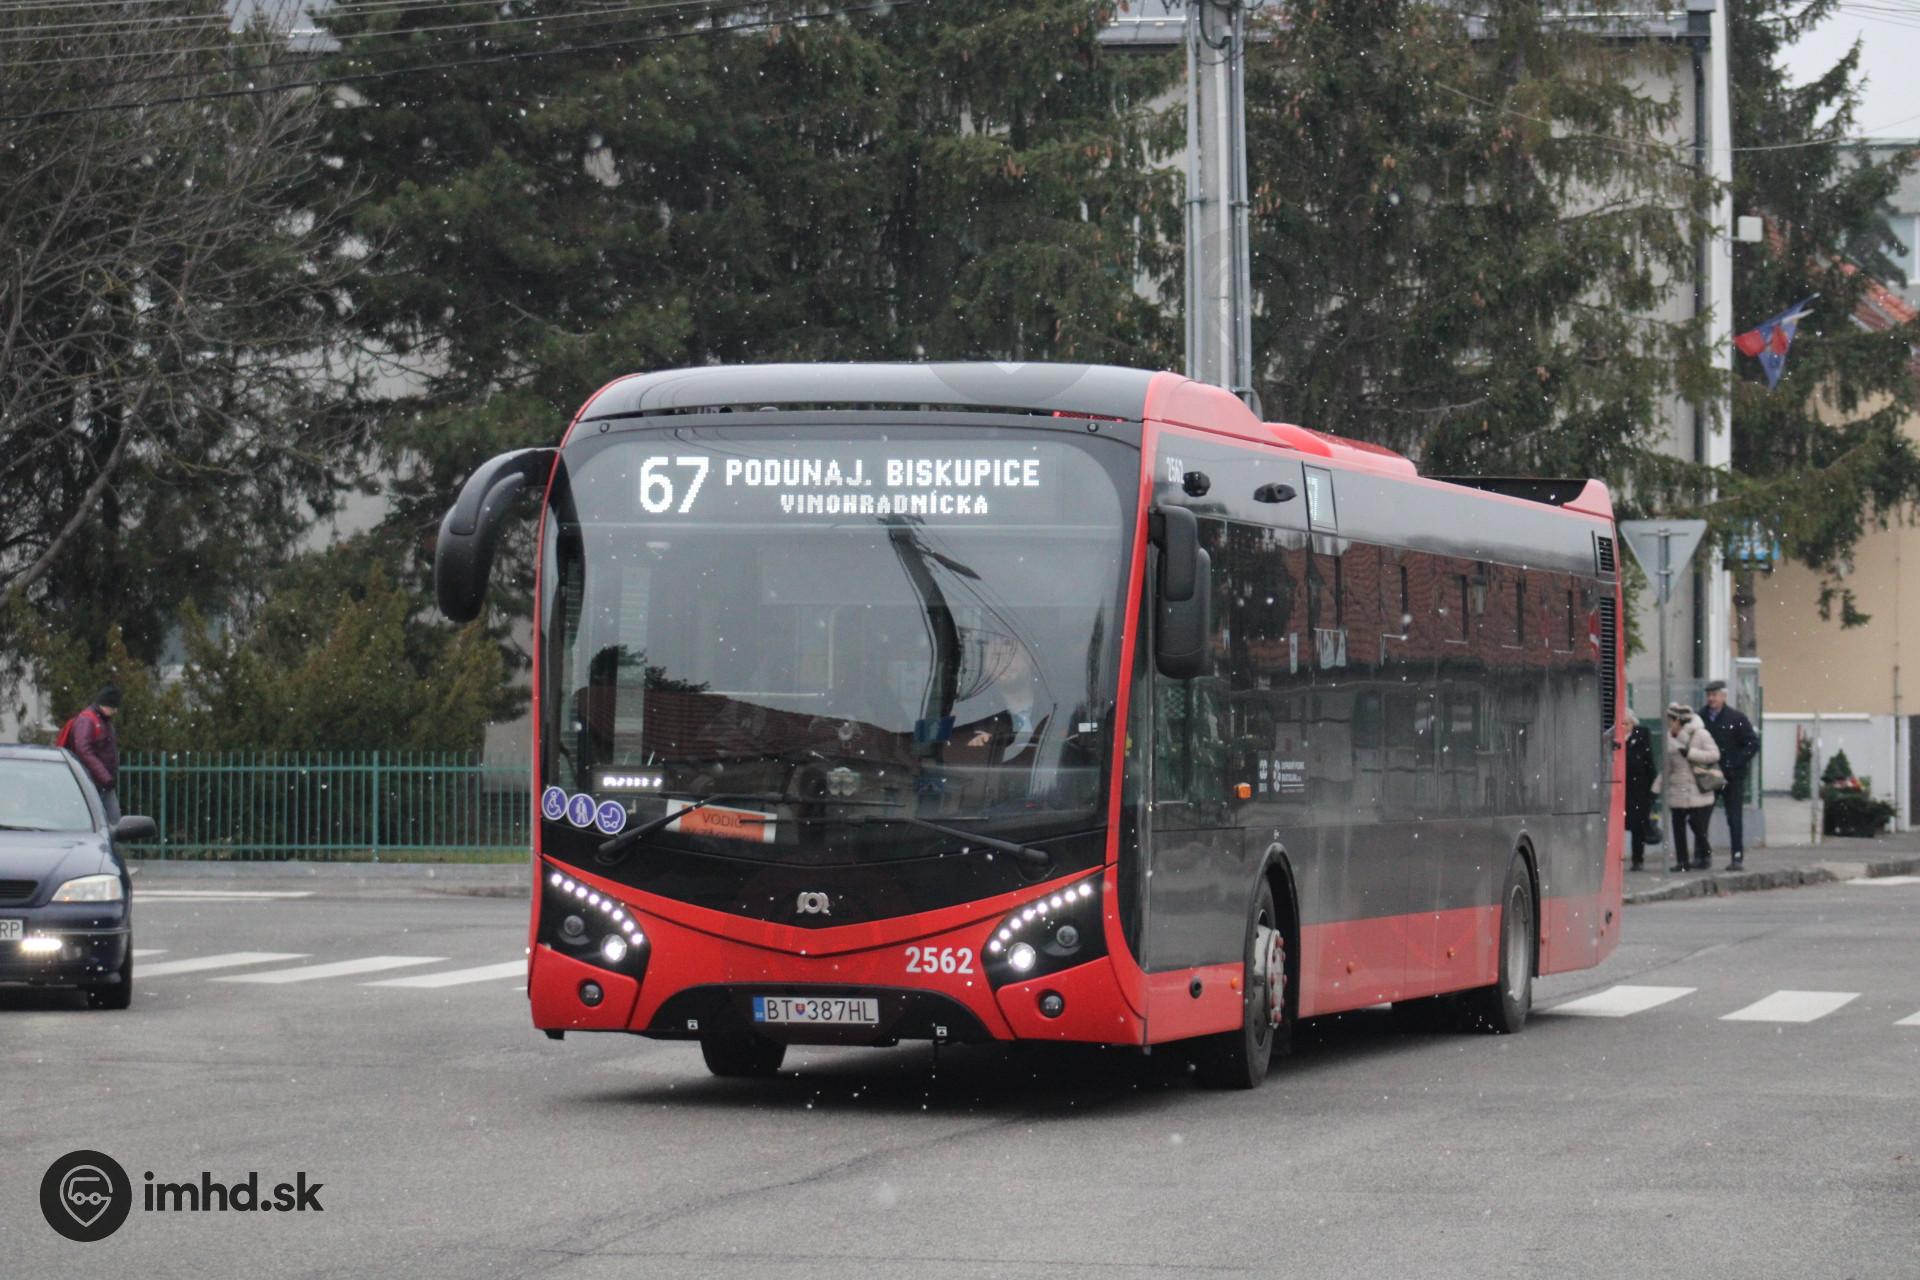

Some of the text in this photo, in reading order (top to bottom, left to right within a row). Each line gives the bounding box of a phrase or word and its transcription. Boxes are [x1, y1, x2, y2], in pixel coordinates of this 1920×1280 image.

[640, 457, 1041, 513] 67 PODUNAJ. BISKUPICE
[780, 490, 989, 514] VINOHRADNÍCKA
[905, 947, 974, 974] 2562
[767, 999, 875, 1021] BT 387HL
